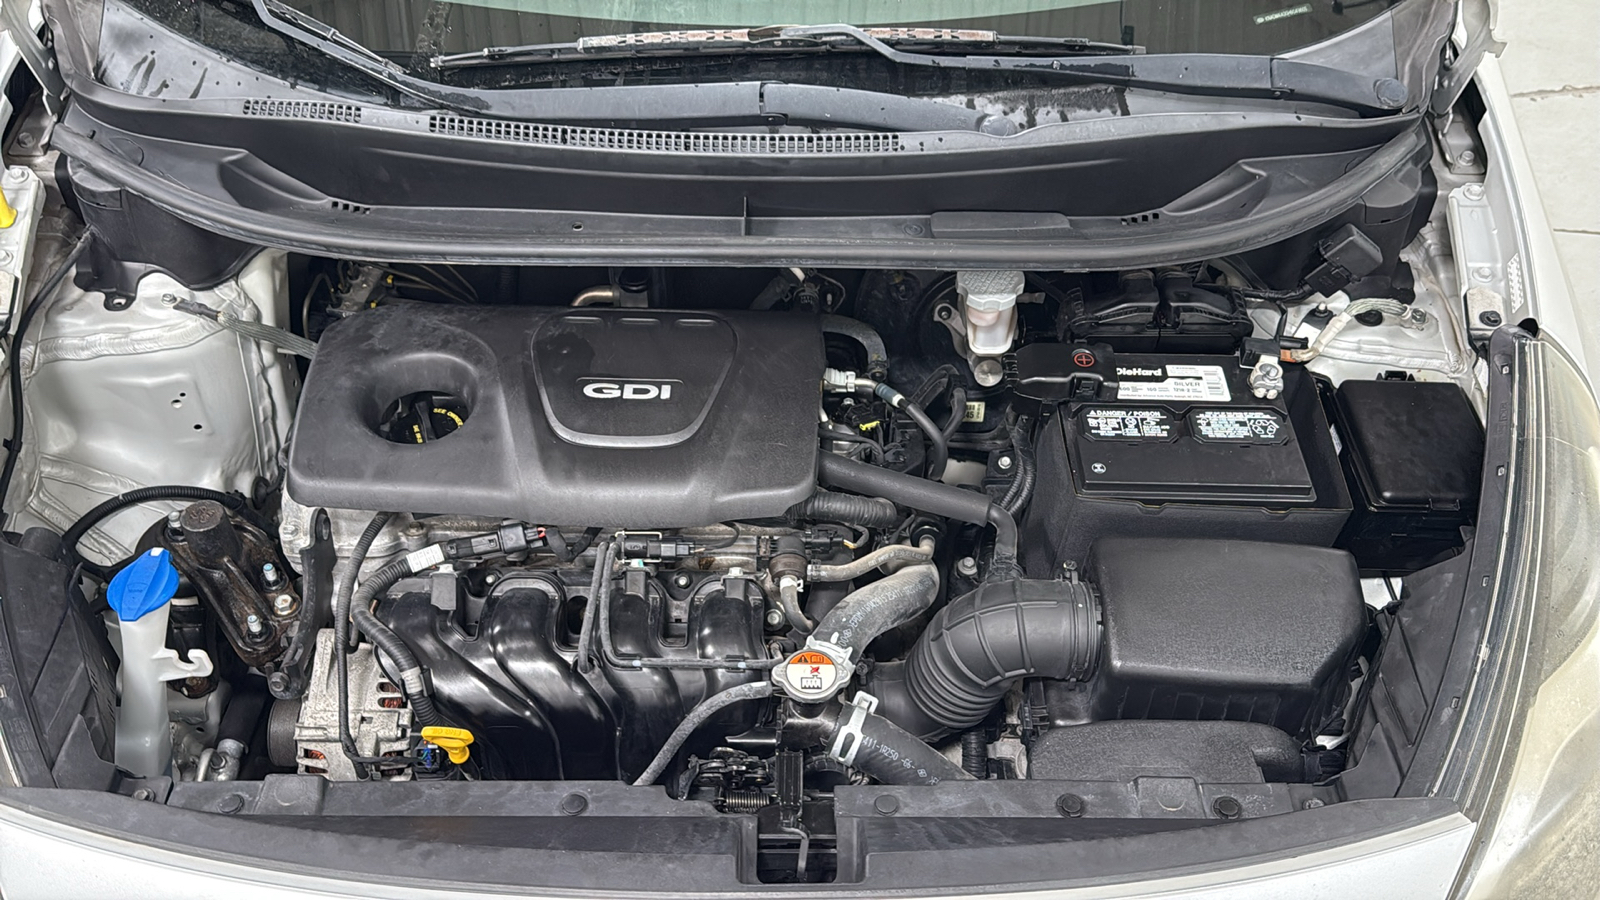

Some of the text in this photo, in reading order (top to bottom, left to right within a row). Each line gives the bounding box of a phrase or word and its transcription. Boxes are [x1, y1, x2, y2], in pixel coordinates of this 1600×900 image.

[1116, 367, 1162, 376] DieHard
[583, 382, 671, 400] GDI
[862, 735, 899, 760] 411-1R250
